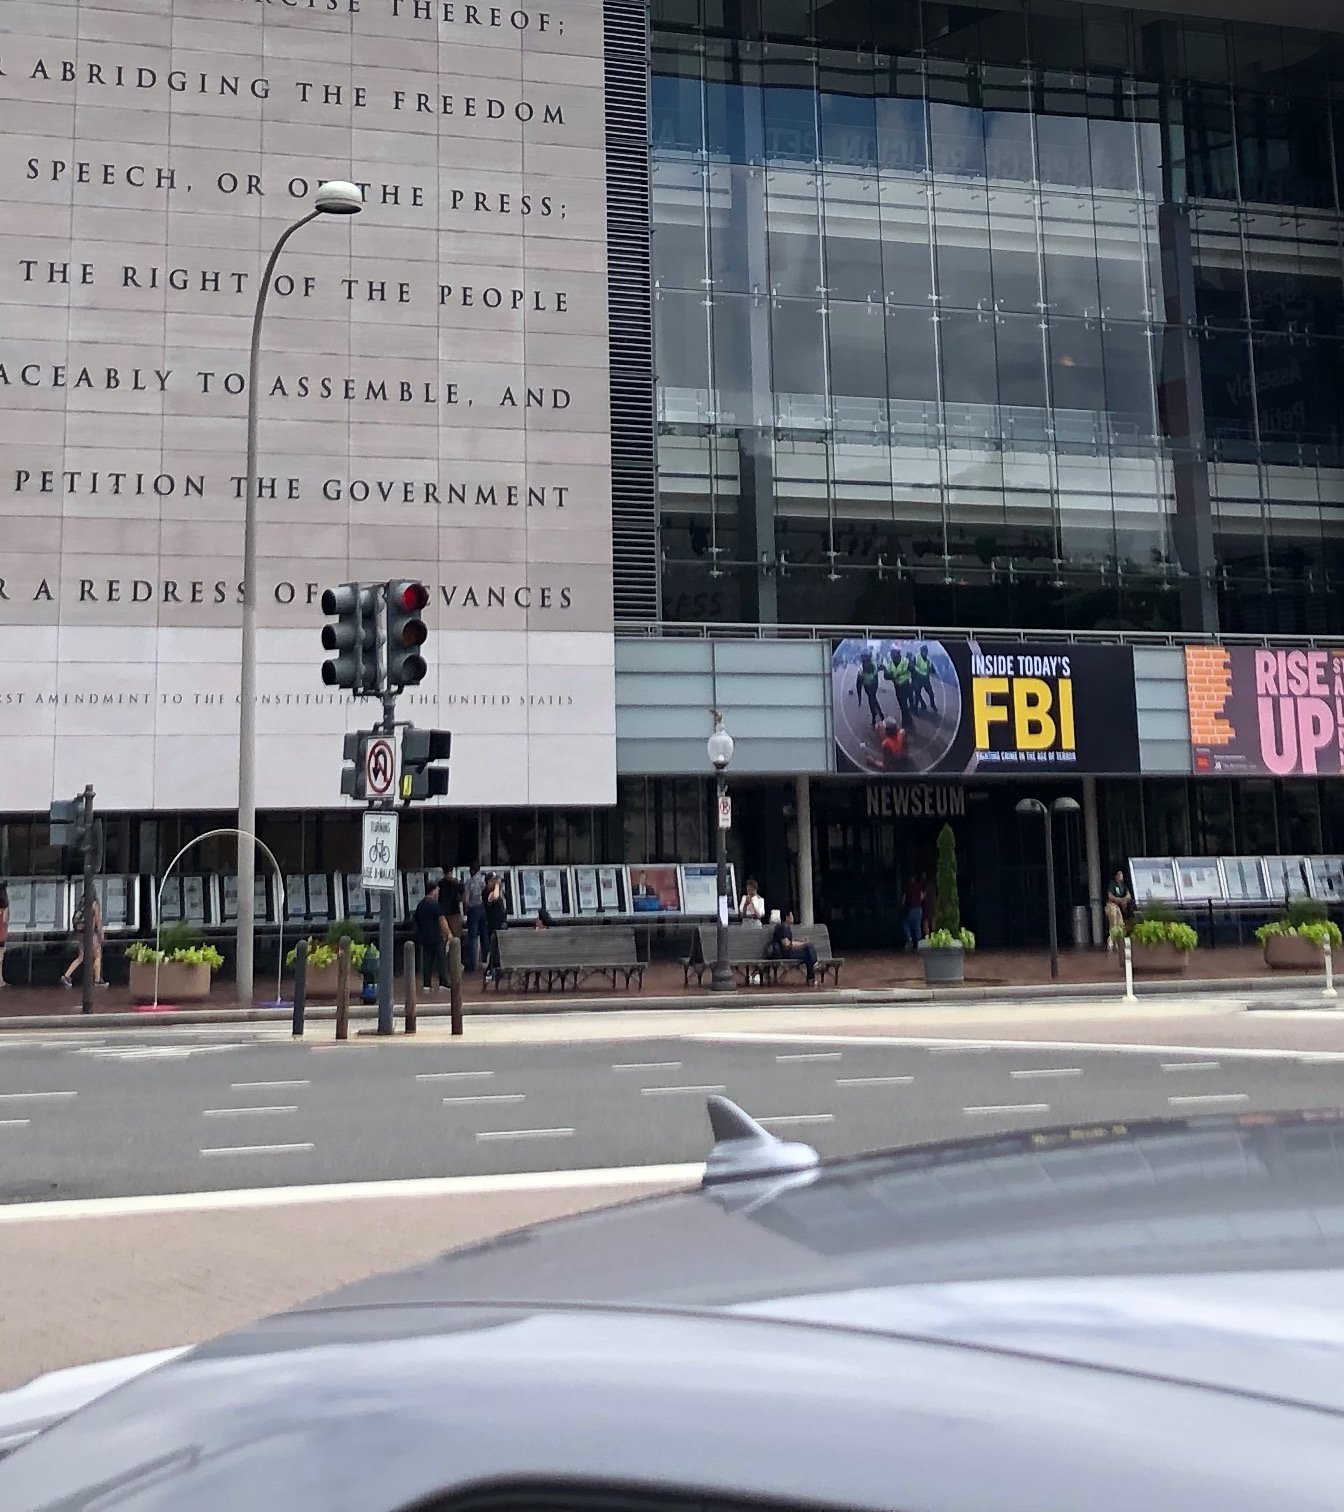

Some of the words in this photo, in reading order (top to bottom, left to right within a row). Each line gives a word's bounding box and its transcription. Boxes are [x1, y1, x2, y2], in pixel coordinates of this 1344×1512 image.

[29, 58, 271, 99] ABRIDGING
[295, 81, 367, 108] THE
[393, 90, 566, 125] FREEDOM
[26, 158, 192, 193] SPEECH,
[217, 172, 266, 197] OR
[354, 182, 424, 208] THE
[450, 189, 566, 220] PRESS;
[18, 259, 94, 285] THE
[122, 265, 249, 294] RIGHT
[273, 274, 316, 298] OF
[340, 278, 410, 304] THE
[438, 284, 568, 313] PEOPLE
[196, 371, 245, 395] TO
[268, 375, 473, 408] ASSEMBLE,
[499, 386, 571, 410] AND
[14, 469, 205, 498] PETITION
[229, 475, 300, 501] THE
[322, 479, 569, 508] GOVERNMENT
[32, 578, 55, 601] A
[274, 581, 319, 605] OF
[971, 653, 1014, 676] INSIDE
[1017, 655, 1071, 677] TODAY'S
[1254, 649, 1330, 696] RISE
[35, 692, 151, 708] AMENDMENT
[161, 693, 183, 705] TO
[193, 693, 224, 706] THE
[234, 692, 369, 706] CNSTITUTION
[410, 694, 440, 706] THE
[448, 694, 511, 706] UNITED
[519, 693, 573, 706] STATES
[972, 676, 1076, 751] FBI
[1257, 696, 1335, 776] UP
[866, 785, 966, 817] NEWSEUM
